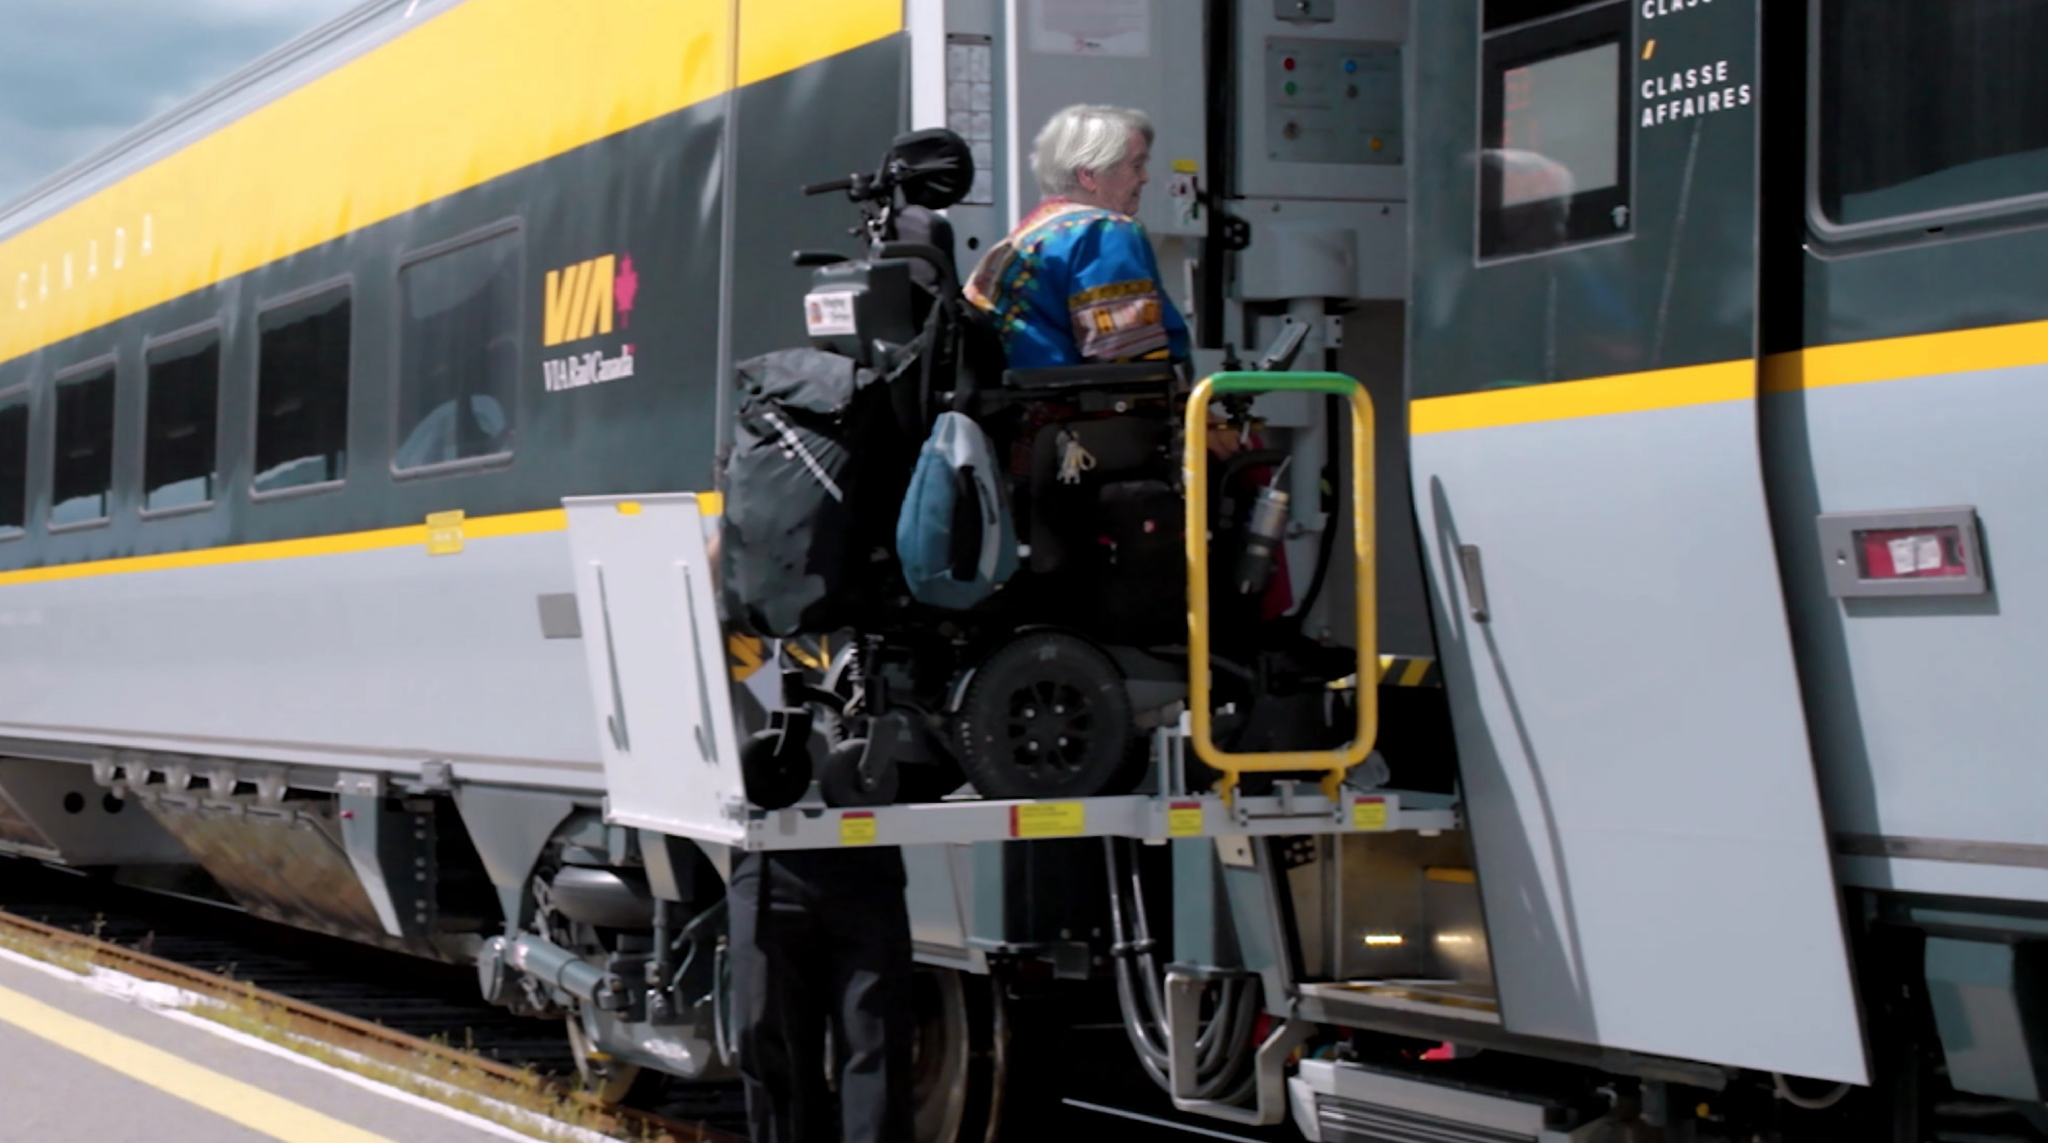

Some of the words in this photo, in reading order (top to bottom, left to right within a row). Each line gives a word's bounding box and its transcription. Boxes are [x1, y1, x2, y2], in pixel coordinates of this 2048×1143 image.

[1642, 0, 1712, 18] CLA
[1642, 61, 1727, 98] CLASSE
[1641, 85, 1750, 127] AFFAIRES
[16, 214, 152, 310] CANADA
[543, 254, 615, 346] VIA
